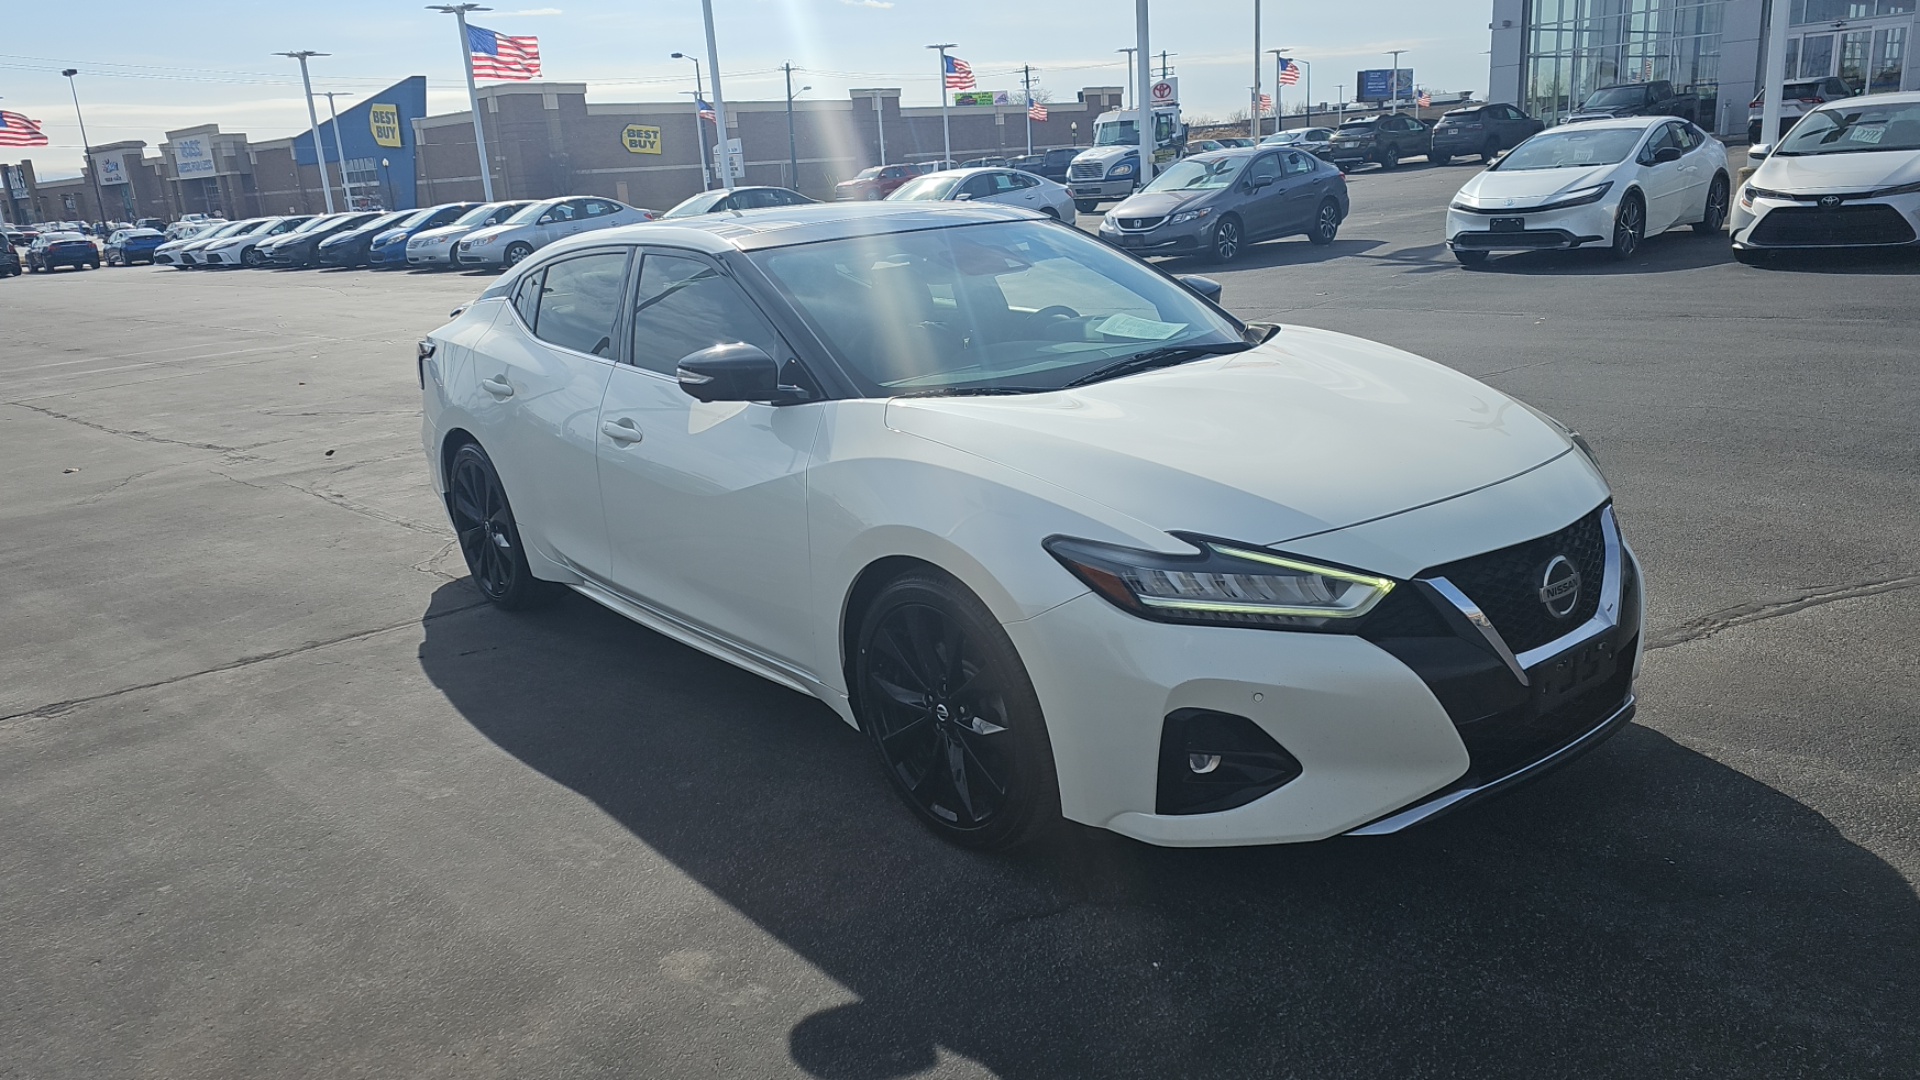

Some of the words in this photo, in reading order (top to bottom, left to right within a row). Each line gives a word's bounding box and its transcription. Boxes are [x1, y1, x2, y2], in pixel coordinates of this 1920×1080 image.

[372, 110, 396, 124] BEST
[376, 125, 396, 139] BUY
[627, 129, 659, 139] BEST
[629, 139, 657, 149] BUY
[1547, 577, 1578, 598] NISSAN
